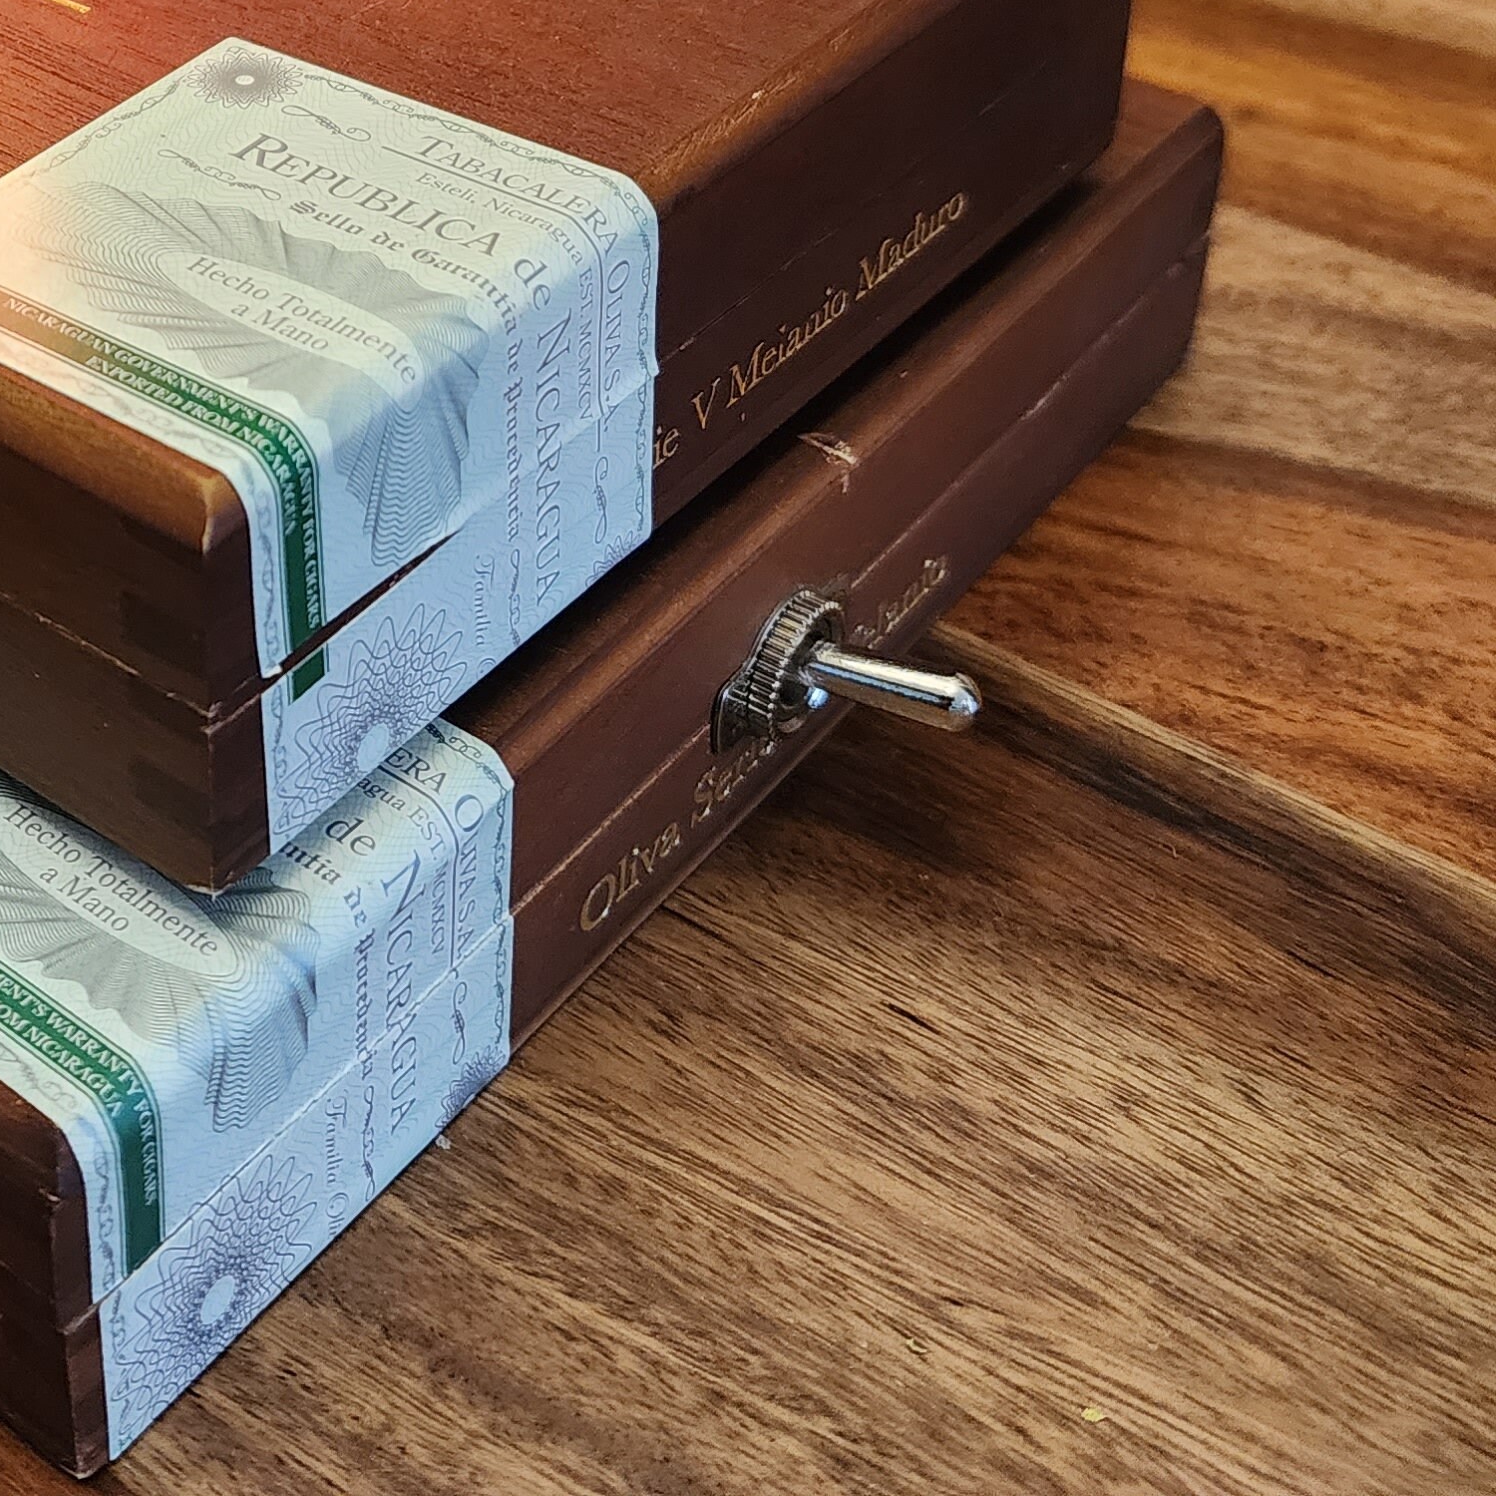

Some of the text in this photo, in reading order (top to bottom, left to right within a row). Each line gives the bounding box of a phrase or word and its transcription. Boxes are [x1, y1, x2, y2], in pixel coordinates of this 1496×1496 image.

[289, 200, 365, 236] Sello
[370, 231, 406, 252] de
[414, 135, 622, 258] TABACALERA
[481, 198, 584, 266] Nicaragua
[185, 255, 417, 385] Hecho Totalmente
[229, 133, 572, 607] REPUBLICA de NICARAGUA
[230, 302, 330, 353] a Mano
[691, 377, 721, 430] V
[855, 192, 967, 301] Maduro
[5, 298, 116, 354] NICARAGUAN
[113, 348, 260, 422] GOVERNMENT'S
[258, 413, 315, 516] WARRANTY
[305, 559, 321, 630] CIGARS
[85, 355, 298, 535] EXPORTED FROM NICARAGUA
[3, 804, 219, 956] Hecho Totalmente
[407, 807, 446, 861] EST.
[579, 822, 681, 932] Oliva
[39, 867, 130, 933] a Mano
[325, 817, 376, 857] de
[381, 850, 426, 1135] NICARAGUA
[23, 1026, 124, 1118] NICARAGUA
[44, 1012, 145, 1097] WARRANTY
[133, 1098, 154, 1143] FOR
